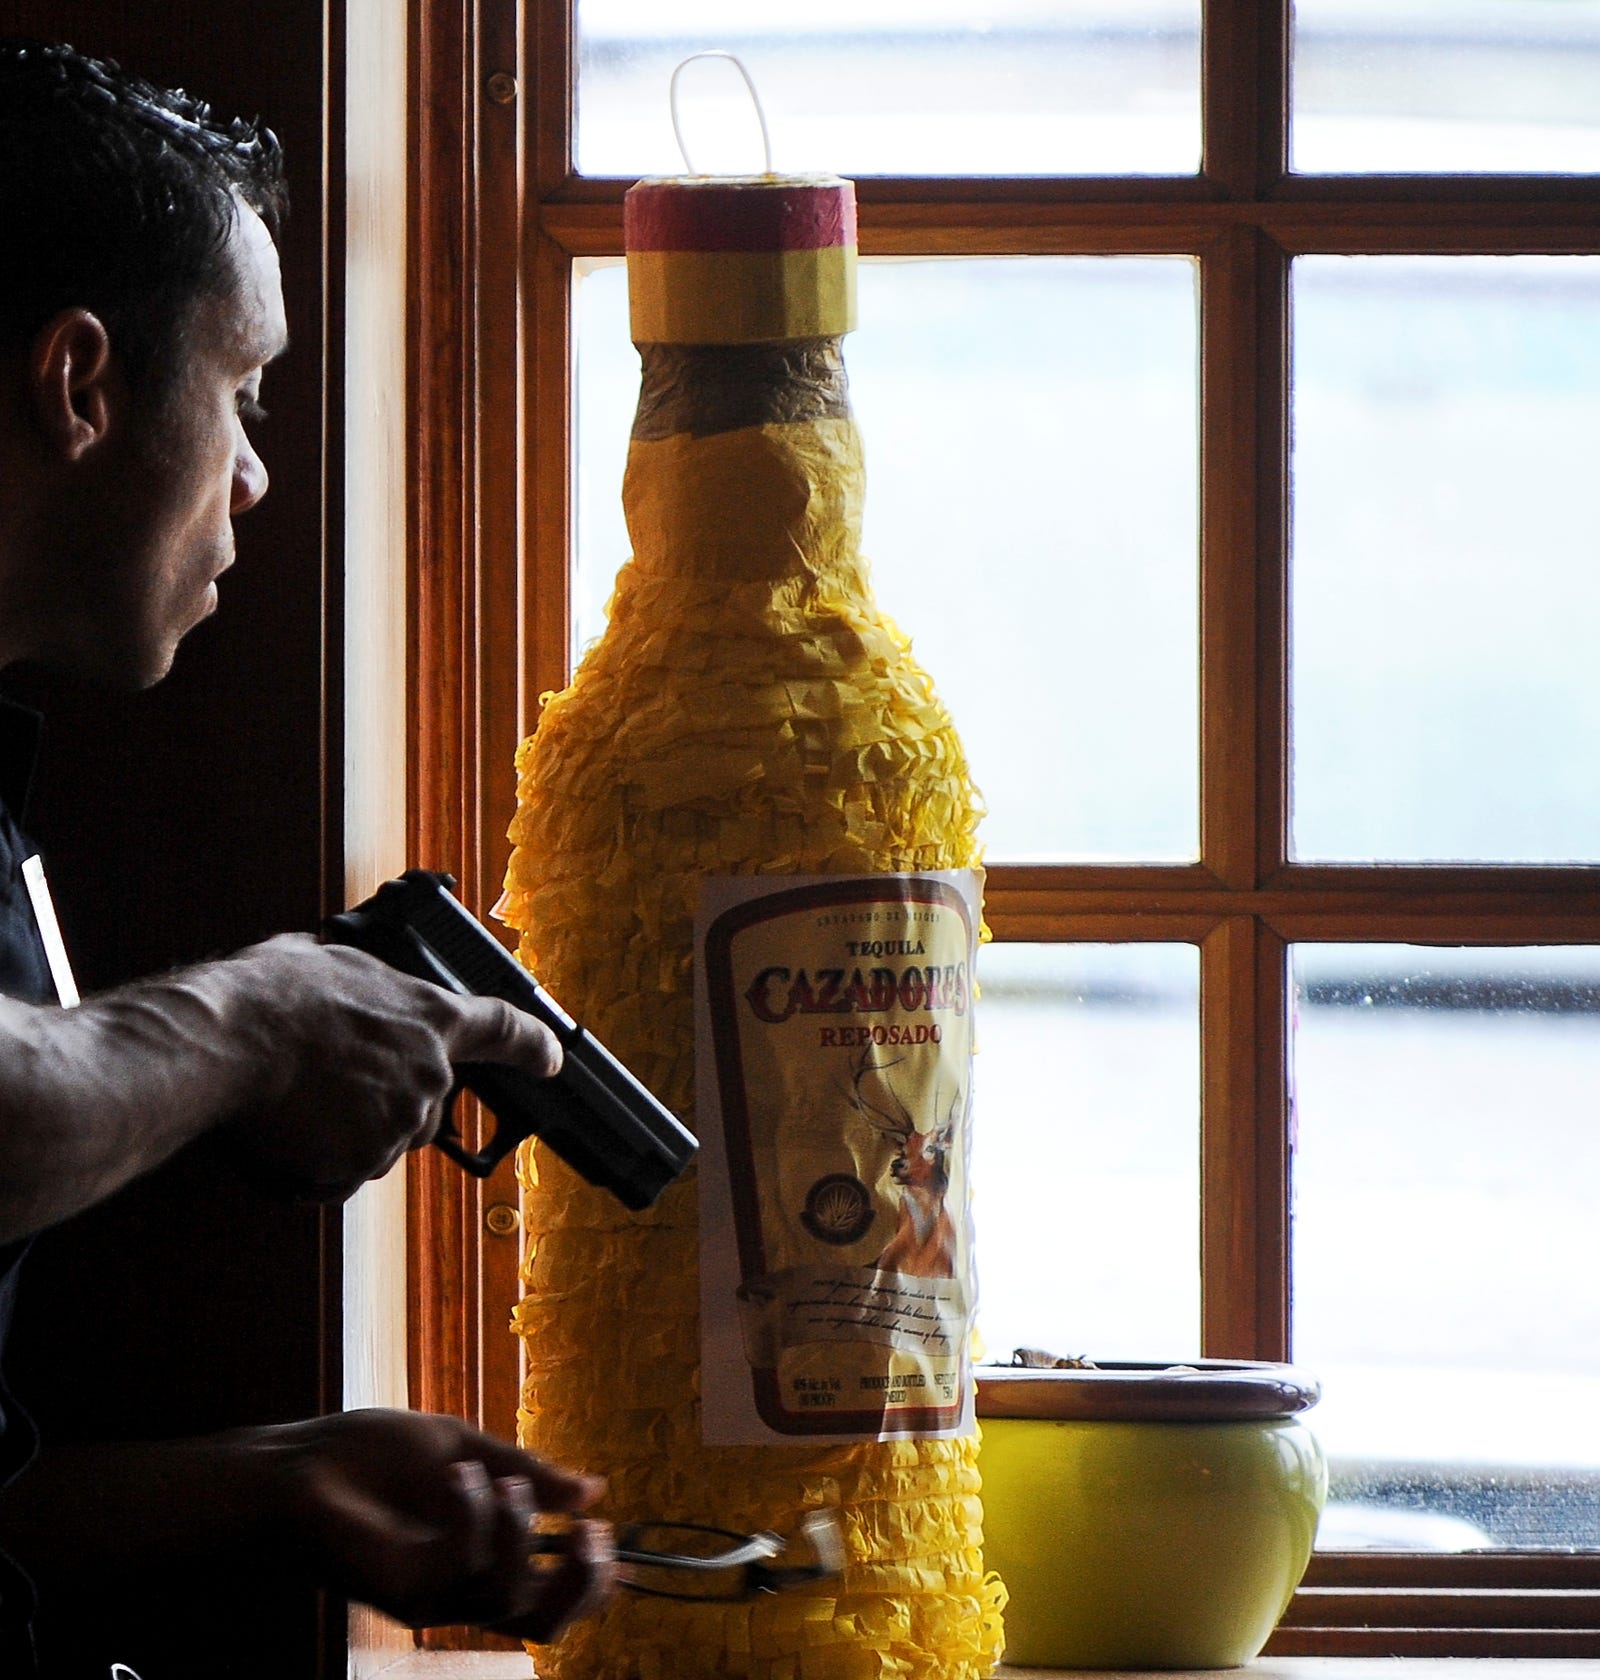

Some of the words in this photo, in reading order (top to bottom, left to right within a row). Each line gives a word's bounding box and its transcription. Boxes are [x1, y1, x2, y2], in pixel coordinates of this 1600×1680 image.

[846, 940, 925, 958] TEQUILA
[744, 961, 967, 1023] CAZADORES
[820, 1024, 943, 1047] REPOSADO
